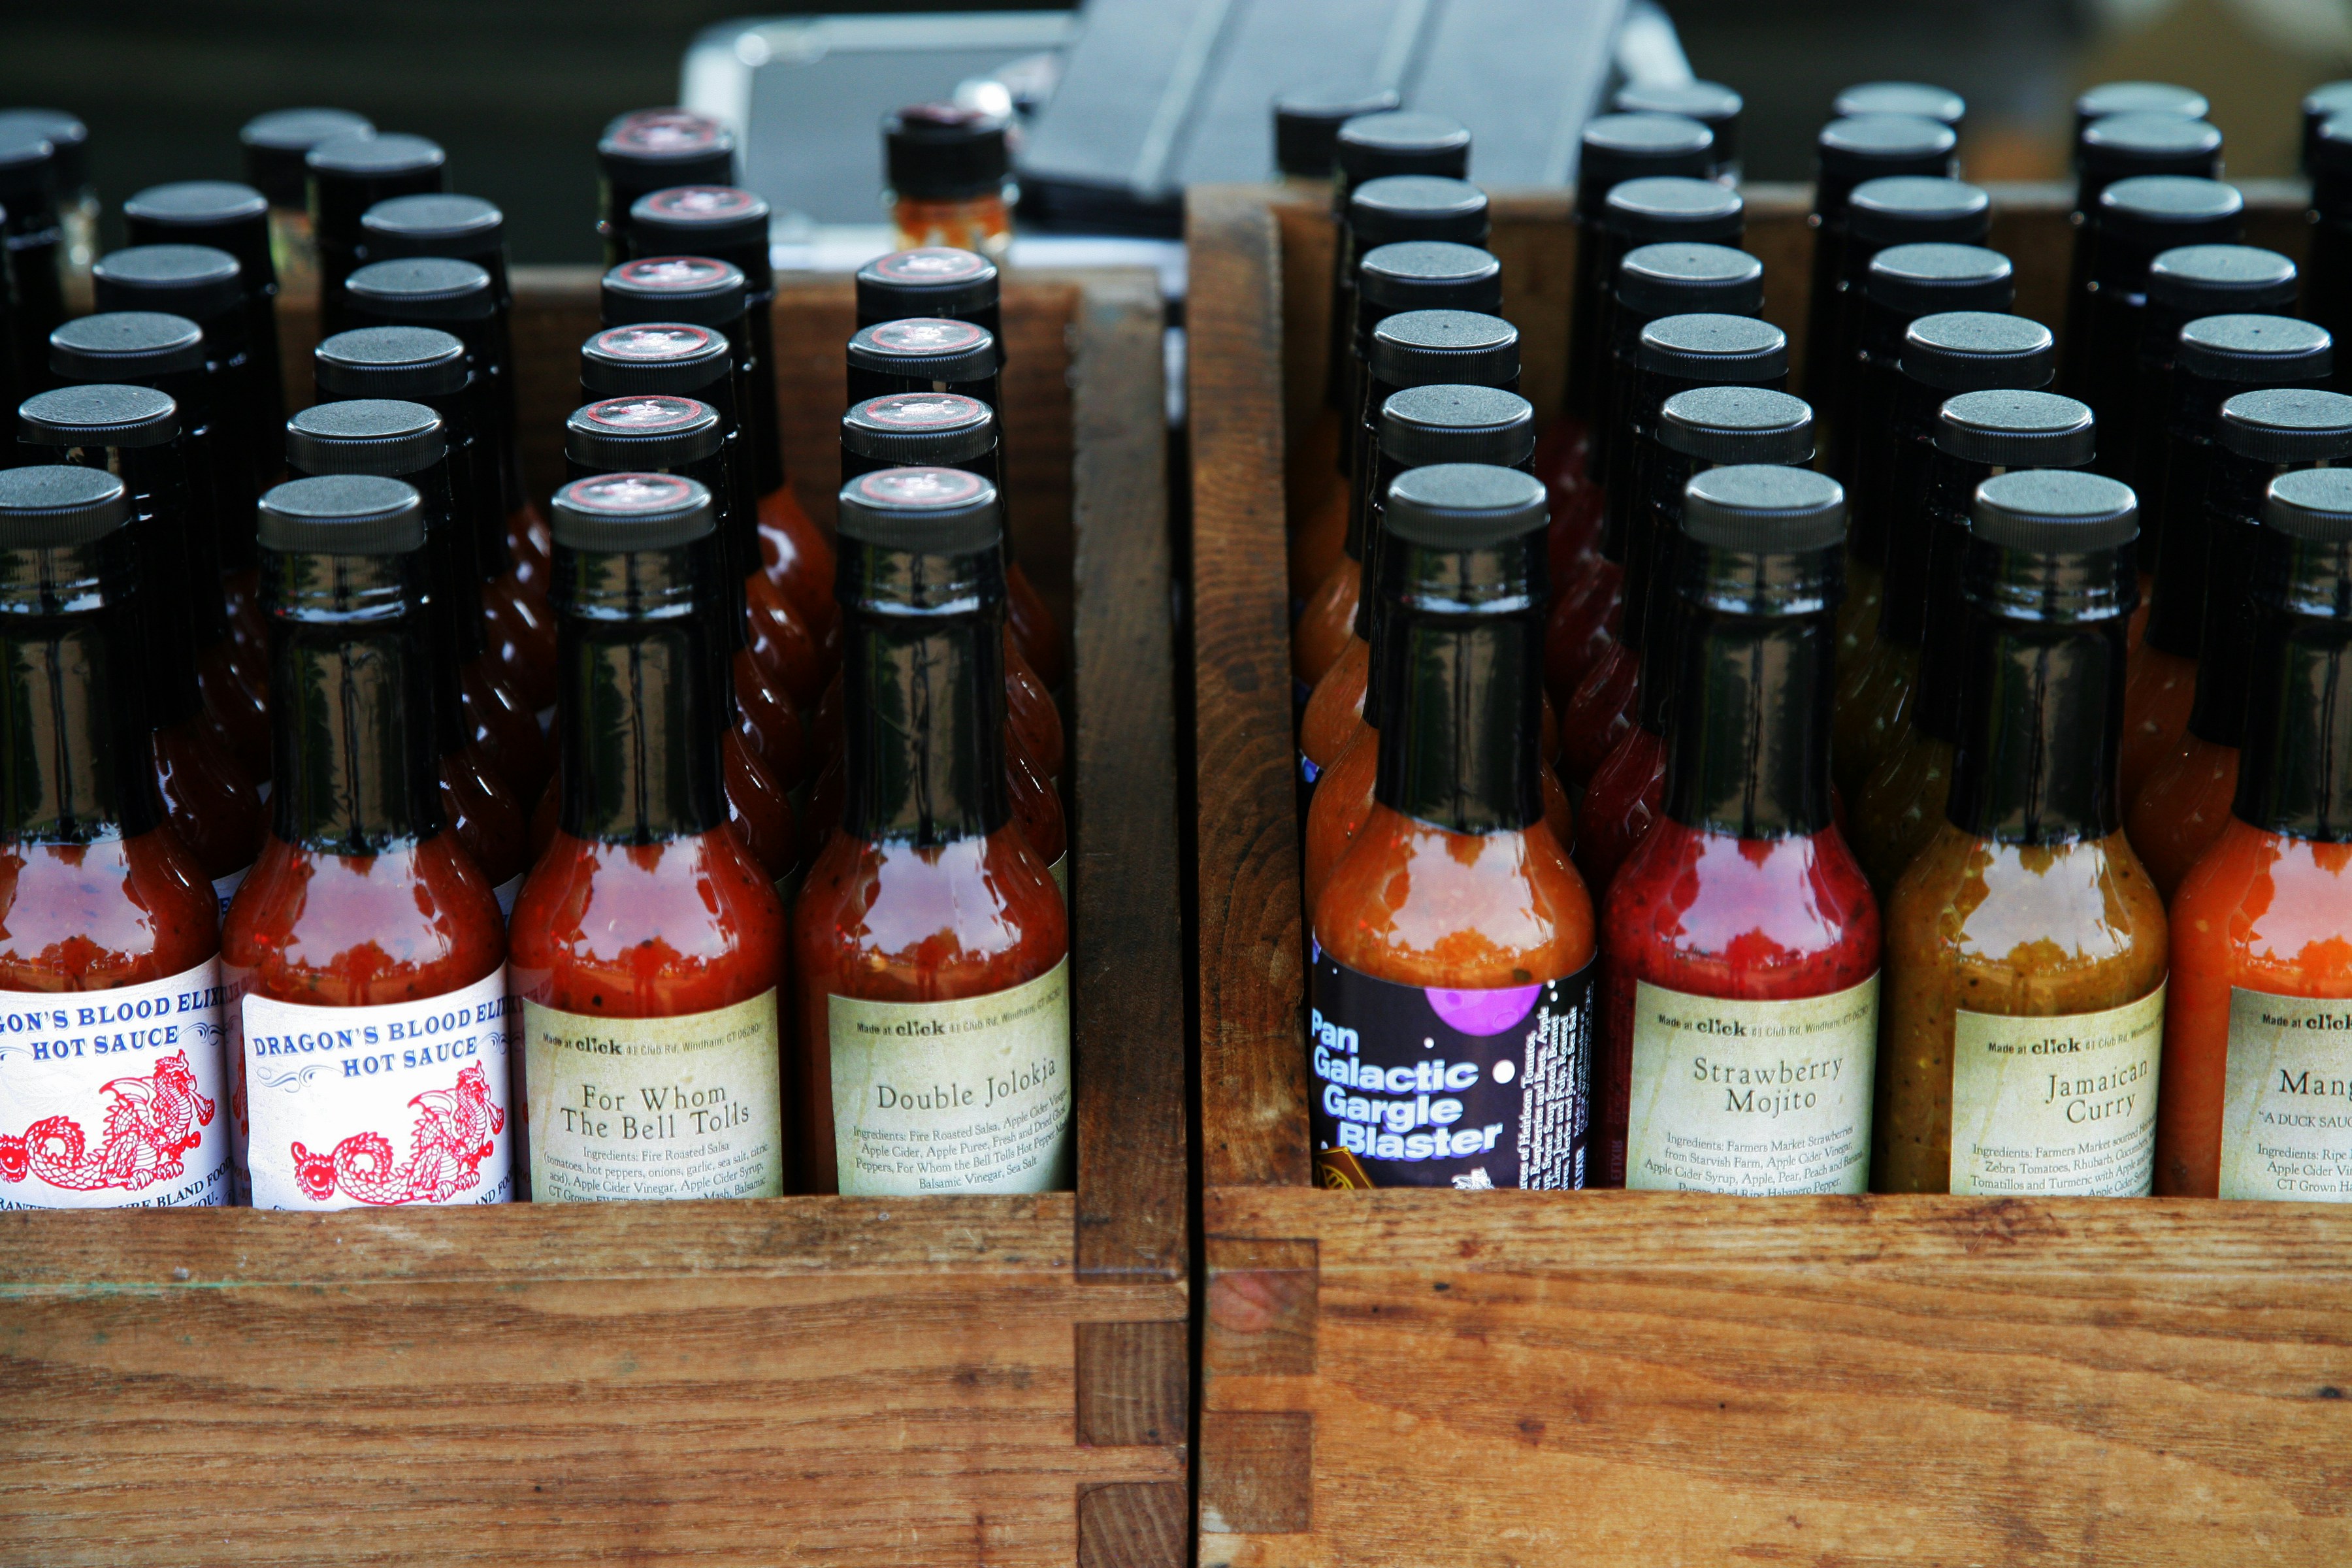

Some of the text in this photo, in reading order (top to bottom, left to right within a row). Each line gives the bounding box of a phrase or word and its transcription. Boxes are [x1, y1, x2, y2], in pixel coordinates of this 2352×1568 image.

[76, 997, 171, 1026] BLOOD
[1537, 1006, 1551, 1045] Apple
[1569, 1005, 1577, 1031] Salt
[1659, 1015, 1681, 1028] Made
[1697, 1019, 1747, 1036] click
[1767, 1026, 1786, 1036] Club
[2262, 1014, 2289, 1026] Made
[2292, 1019, 2301, 1028] at
[31, 1026, 178, 1060] HOT SAUCE
[252, 1026, 379, 1056] DRAGON'S
[387, 1009, 470, 1041] BLOOD
[543, 1032, 735, 1055] Made at click Club CT
[857, 1021, 945, 1037] Made at click
[1312, 1007, 1359, 1054] Pan
[341, 1036, 476, 1077] HOT SAUCE
[1989, 1043, 2014, 1054] Made
[2032, 1037, 2080, 1054] click
[1314, 1045, 1479, 1094] Galactic
[1535, 1046, 1548, 1083] Beets,
[1565, 1054, 1576, 1096] Spices,
[1694, 1057, 1843, 1085] Strawberry
[877, 1083, 972, 1110] Double
[985, 1058, 1056, 1107] Jolokia
[1517, 1030, 1537, 1161] of Heirloom Tomatos,
[1533, 1083, 1545, 1105] and
[1542, 1014, 1559, 1169] Stone Soup Scotch Bonnet
[2046, 1060, 2148, 1104] Jamaican
[581, 1085, 726, 1111] For Whom
[1323, 1084, 1463, 1135] Gargle
[1552, 1015, 1569, 1188] Lime Juice and Pulp, Roasted
[1565, 1098, 1573, 1120] and
[1726, 1089, 1816, 1119] Mojito
[2067, 1094, 2136, 1124] Curry
[560, 1102, 749, 1139] The Bell Tolls
[853, 1103, 1048, 1141] Ingredients: Fire Roasted Salsa, Apple Cider
[2279, 1114, 2315, 1128] DUCK
[583, 1141, 729, 1162] Ingredients: Fire Roasted Salsa
[862, 1114, 1052, 1160] Apple Cider, Apple Fresh and Dried
[1338, 1122, 1503, 1161] Blaster
[1529, 1105, 1544, 1176] Raspberries
[1562, 1122, 1571, 1160] Herbs
[1668, 1126, 1854, 1152] Ingredients: Farmers Market Strawberries
[1973, 1144, 2032, 1158] Ingredients:
[2036, 1147, 2075, 1158] Farmers
[2079, 1139, 2110, 1154] Market
[544, 1143, 768, 1179] (tomatoes, hot peppers, onions, garlic, sea citric
[856, 1131, 1055, 1174] Peppers, For Whom the Bell Tolls Hot Pepper
[1665, 1143, 1853, 1169] from Starvish Farm, Apple Cider Vinegar,
[1985, 1154, 2114, 1174] Zebra Tomatoes, Rhubarb,
[2258, 1143, 2347, 1162] Ingredients: Ripe
[550, 1163, 764, 1196] acid), Apple Cider Vinegar, Apple Cider Syrup,
[920, 1156, 1037, 1189] Balsamic Vinegar, Sea Salt
[1575, 1145, 1585, 1191] ELIXIR
[1645, 1158, 1842, 1187] Apple Cider Syrup, Apple, Pear, Peach and
[1970, 1175, 2024, 1190] Tomatillos
[2027, 1179, 2045, 1190] and
[2049, 1175, 2092, 1189] Turmeric
[2095, 1169, 2114, 1183] with
[2116, 1160, 2136, 1176] Apple
[2267, 1161, 2333, 1176] Apple Cider
[157, 1181, 203, 1207] BLAND
[548, 1177, 766, 1198] CT Balsamic
[1814, 1179, 1841, 1193] Pepper,
[2115, 1177, 2133, 1192] Cider
[2278, 1179, 2336, 1192] CT Grown
